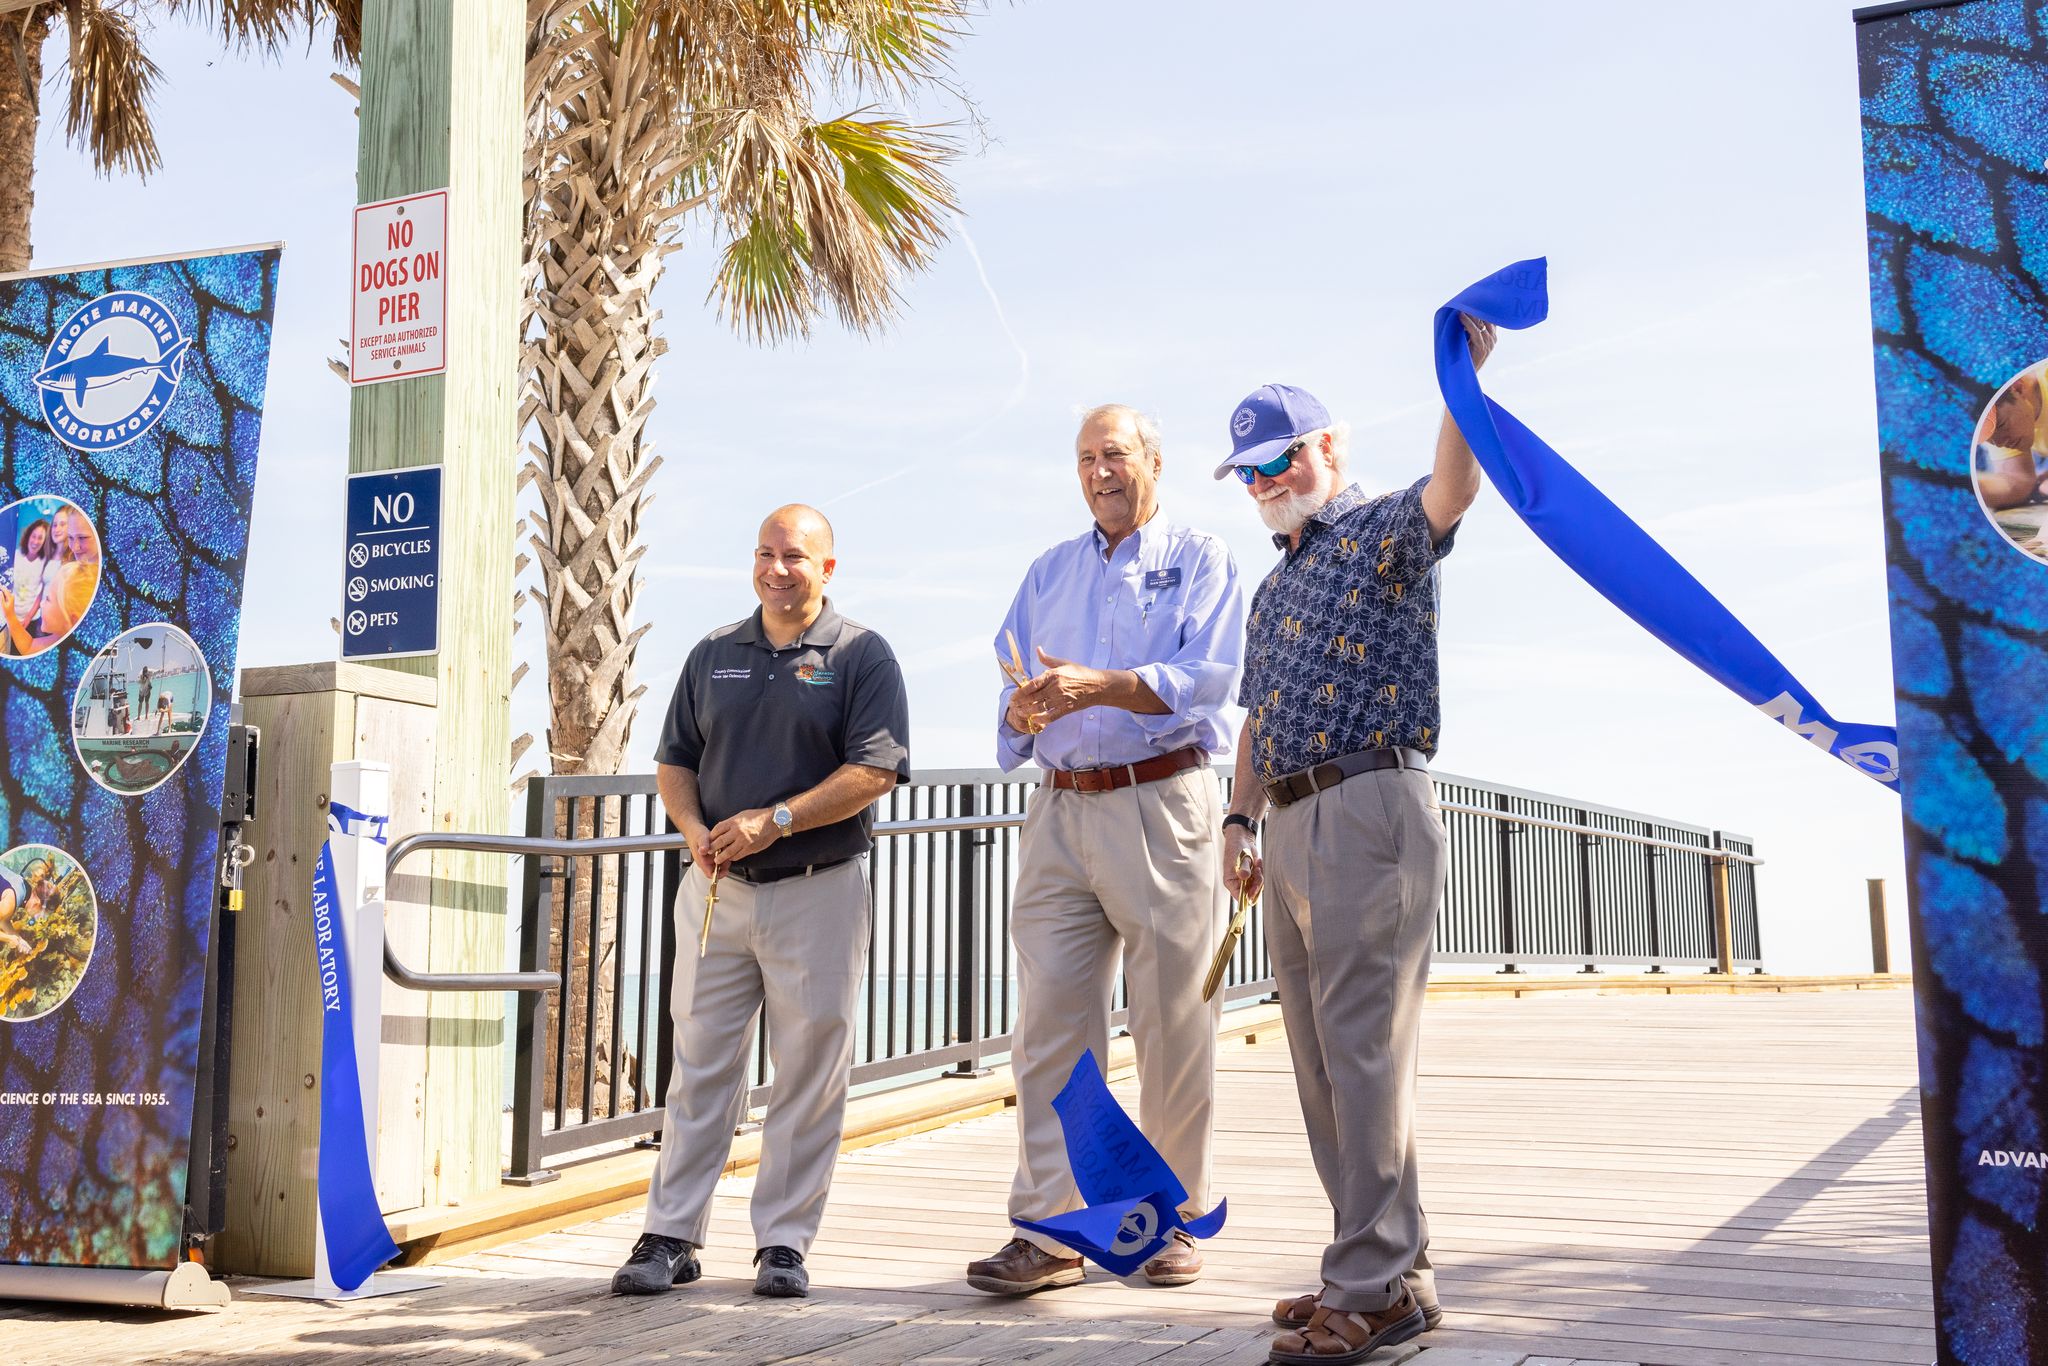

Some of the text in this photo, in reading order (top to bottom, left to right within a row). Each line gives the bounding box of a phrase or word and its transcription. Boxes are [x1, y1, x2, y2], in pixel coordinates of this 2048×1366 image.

[387, 219, 413, 250] NO
[361, 250, 439, 292] DOGS ON
[378, 291, 420, 326] PIER
[57, 300, 173, 355] MOTE MARINE
[360, 325, 438, 349] EXCEPT ADA AUTHORIZED
[370, 341, 426, 361] SERVICE ANIMALS
[52, 394, 161, 443] LABORATORY
[372, 492, 415, 526] NO
[371, 539, 431, 558] BICYCLES
[370, 573, 434, 593] SMOKING
[369, 611, 399, 627] PETS
[312, 875, 341, 1012] LABORATORY
[42, 1092, 57, 1105] OF
[60, 1093, 79, 1105] THE
[82, 1093, 103, 1105] SEA
[106, 1093, 136, 1105] SINCE
[139, 1093, 170, 1106] 1955.
